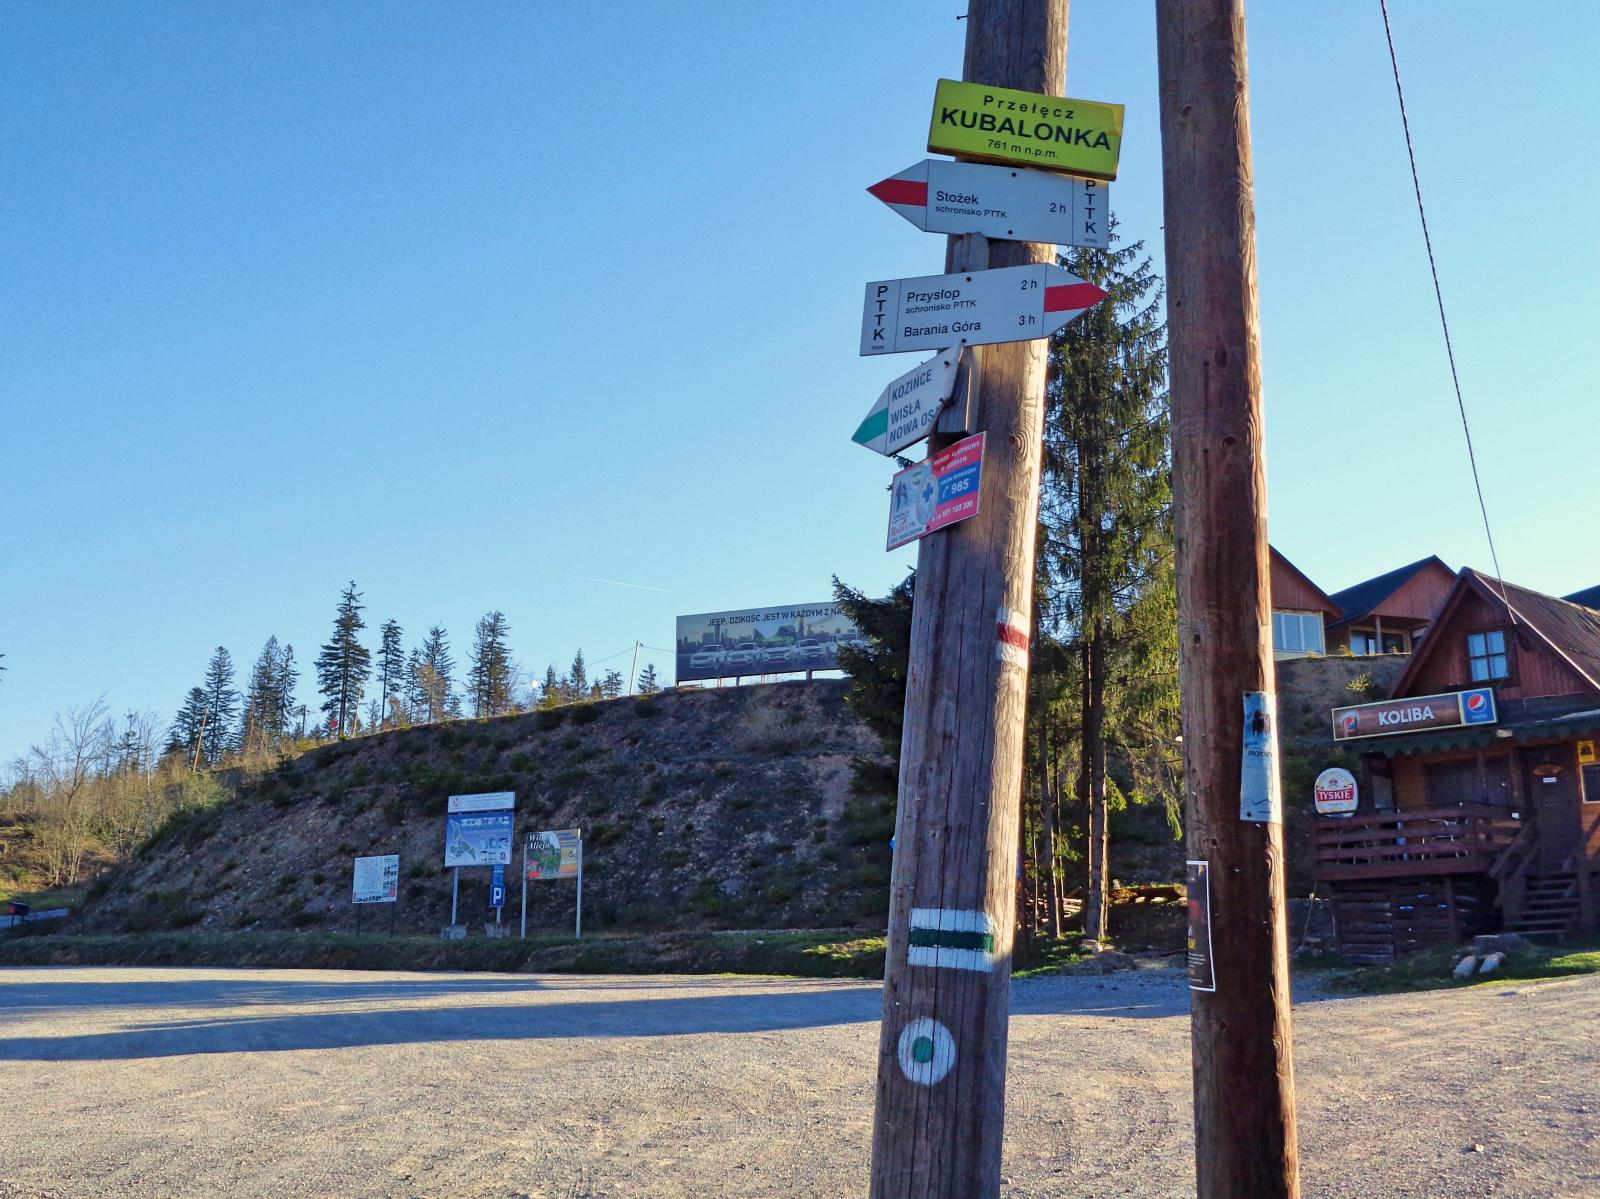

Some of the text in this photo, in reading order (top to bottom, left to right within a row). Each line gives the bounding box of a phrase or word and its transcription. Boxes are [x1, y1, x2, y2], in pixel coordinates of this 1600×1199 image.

[983, 95, 1074, 119] Przełęcz
[941, 107, 1111, 151] KUBALONKA
[1010, 143, 1022, 153] m
[936, 190, 979, 205] Stożek
[936, 205, 1008, 219] schronisko PTTK
[1050, 202, 1067, 214] 2 h
[1020, 278, 1038, 290] 2 h
[906, 288, 961, 303] Przysłop
[905, 300, 977, 314] schronisko PTTK
[1018, 314, 1036, 326] 3 h
[904, 320, 982, 338] Barania Góra
[890, 399, 922, 425] WISŁA
[889, 408, 937, 444] NOWA OS
[763, 612, 780, 622] JEST
[781, 611, 789, 620] W
[824, 607, 830, 616] Z
[1378, 706, 1435, 726] KOLIBA
[1318, 790, 1351, 801] TYSKIE
[493, 887, 502, 905] P
